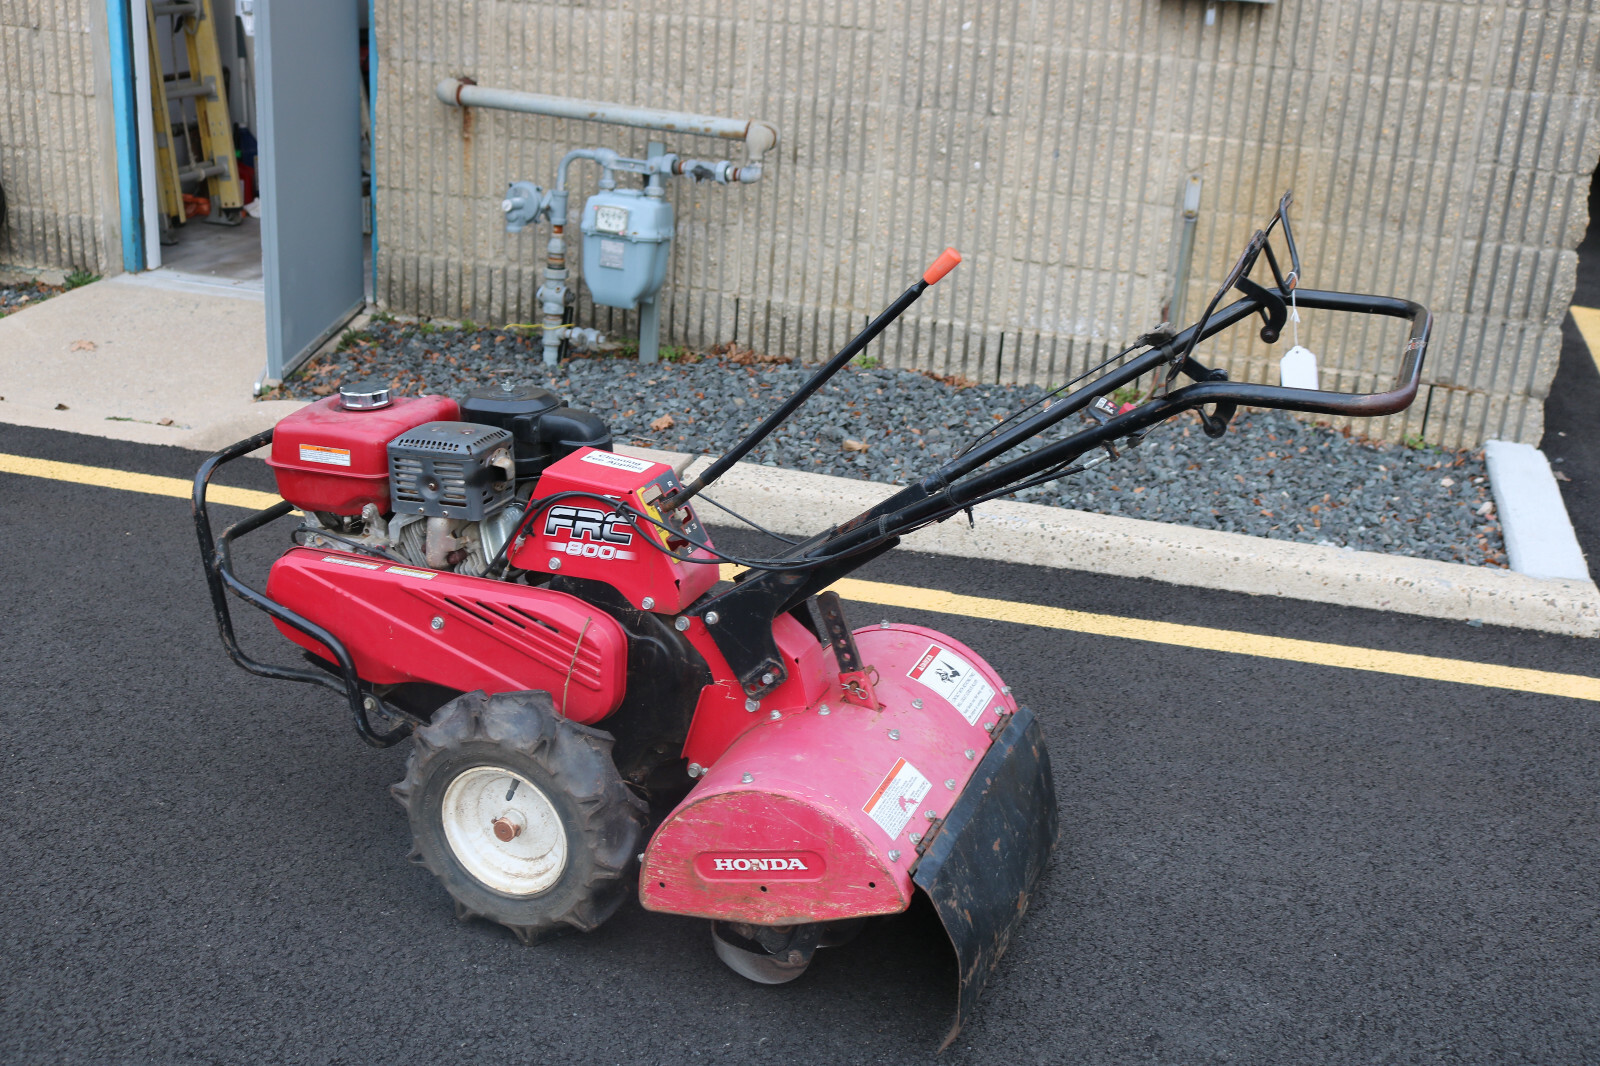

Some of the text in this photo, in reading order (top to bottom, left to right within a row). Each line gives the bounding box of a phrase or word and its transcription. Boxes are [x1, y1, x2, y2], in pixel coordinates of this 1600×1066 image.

[543, 504, 638, 546] FRC
[565, 541, 618, 561] 800
[713, 858, 808, 871] HONDA
